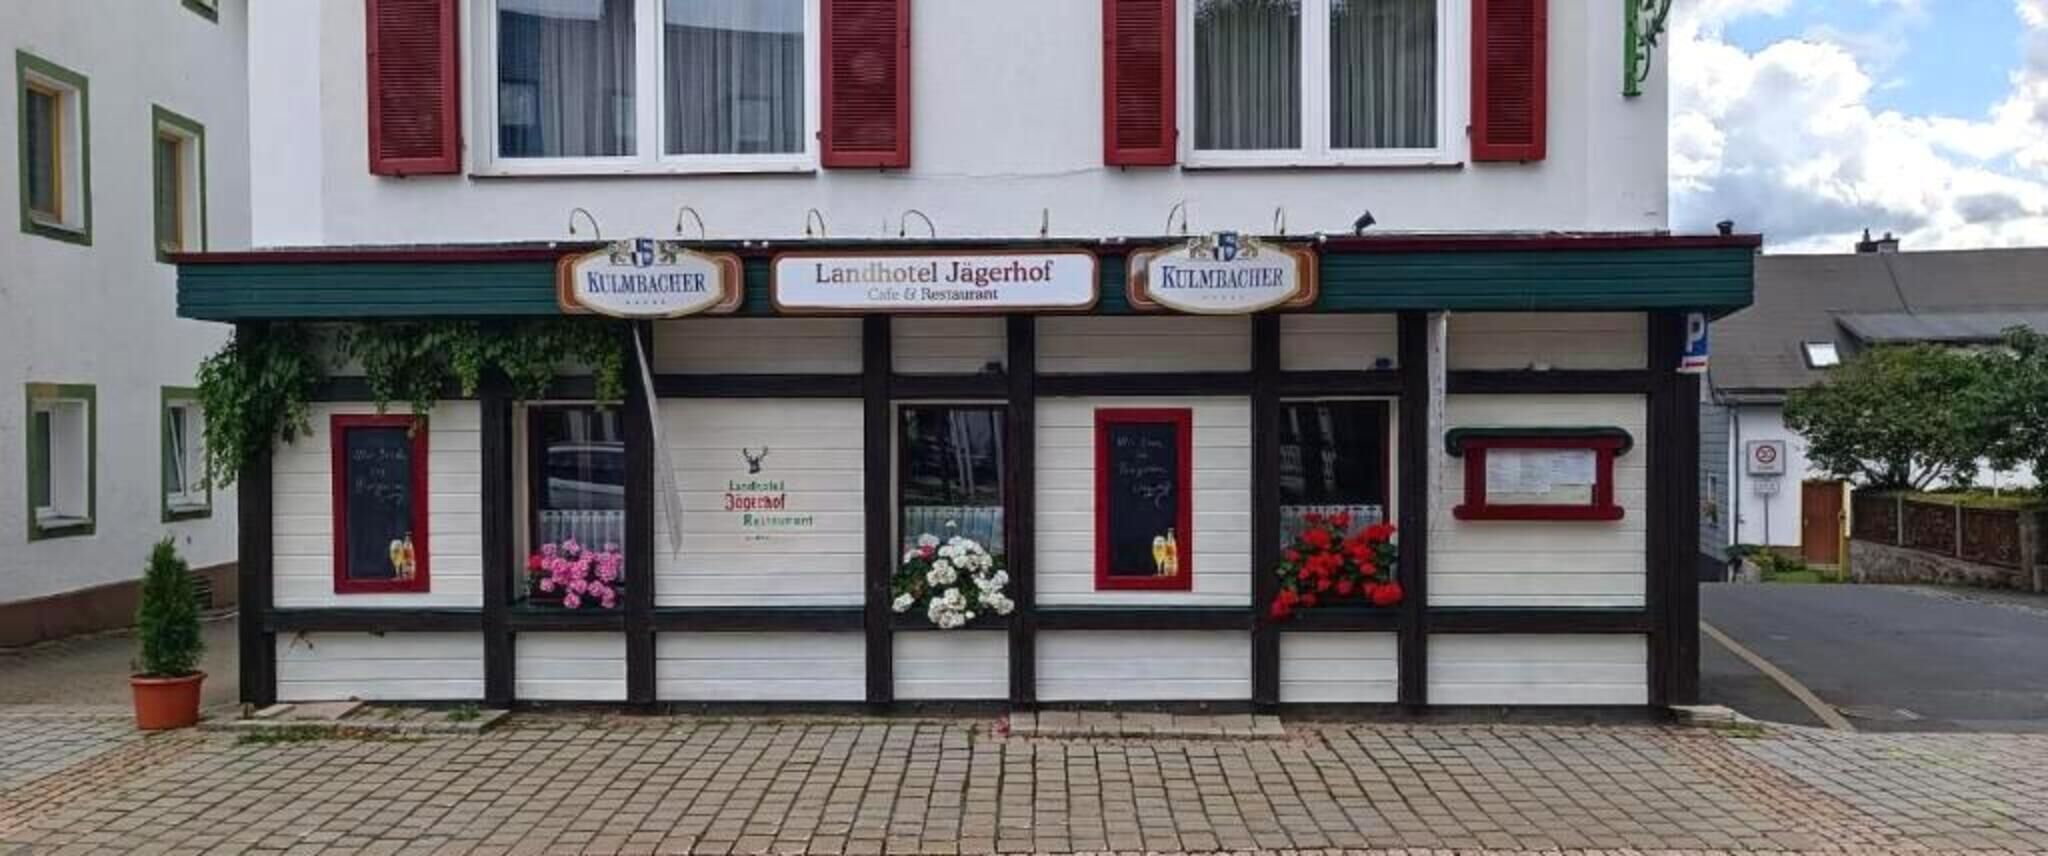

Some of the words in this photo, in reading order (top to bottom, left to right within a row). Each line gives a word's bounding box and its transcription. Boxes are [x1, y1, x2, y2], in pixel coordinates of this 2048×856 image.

[587, 271, 706, 293] KULMBACHER
[816, 262, 937, 283] Landhotel
[945, 260, 1054, 287] Jägerhof
[1160, 265, 1283, 289] KULMBACHER
[868, 287, 900, 301] Cafe
[904, 287, 916, 301] &
[921, 287, 999, 301] Restaurant
[1685, 313, 1705, 352] P
[728, 479, 785, 491] Landhotel
[724, 493, 786, 511] Jägerhof
[743, 513, 814, 527] Restaurant
